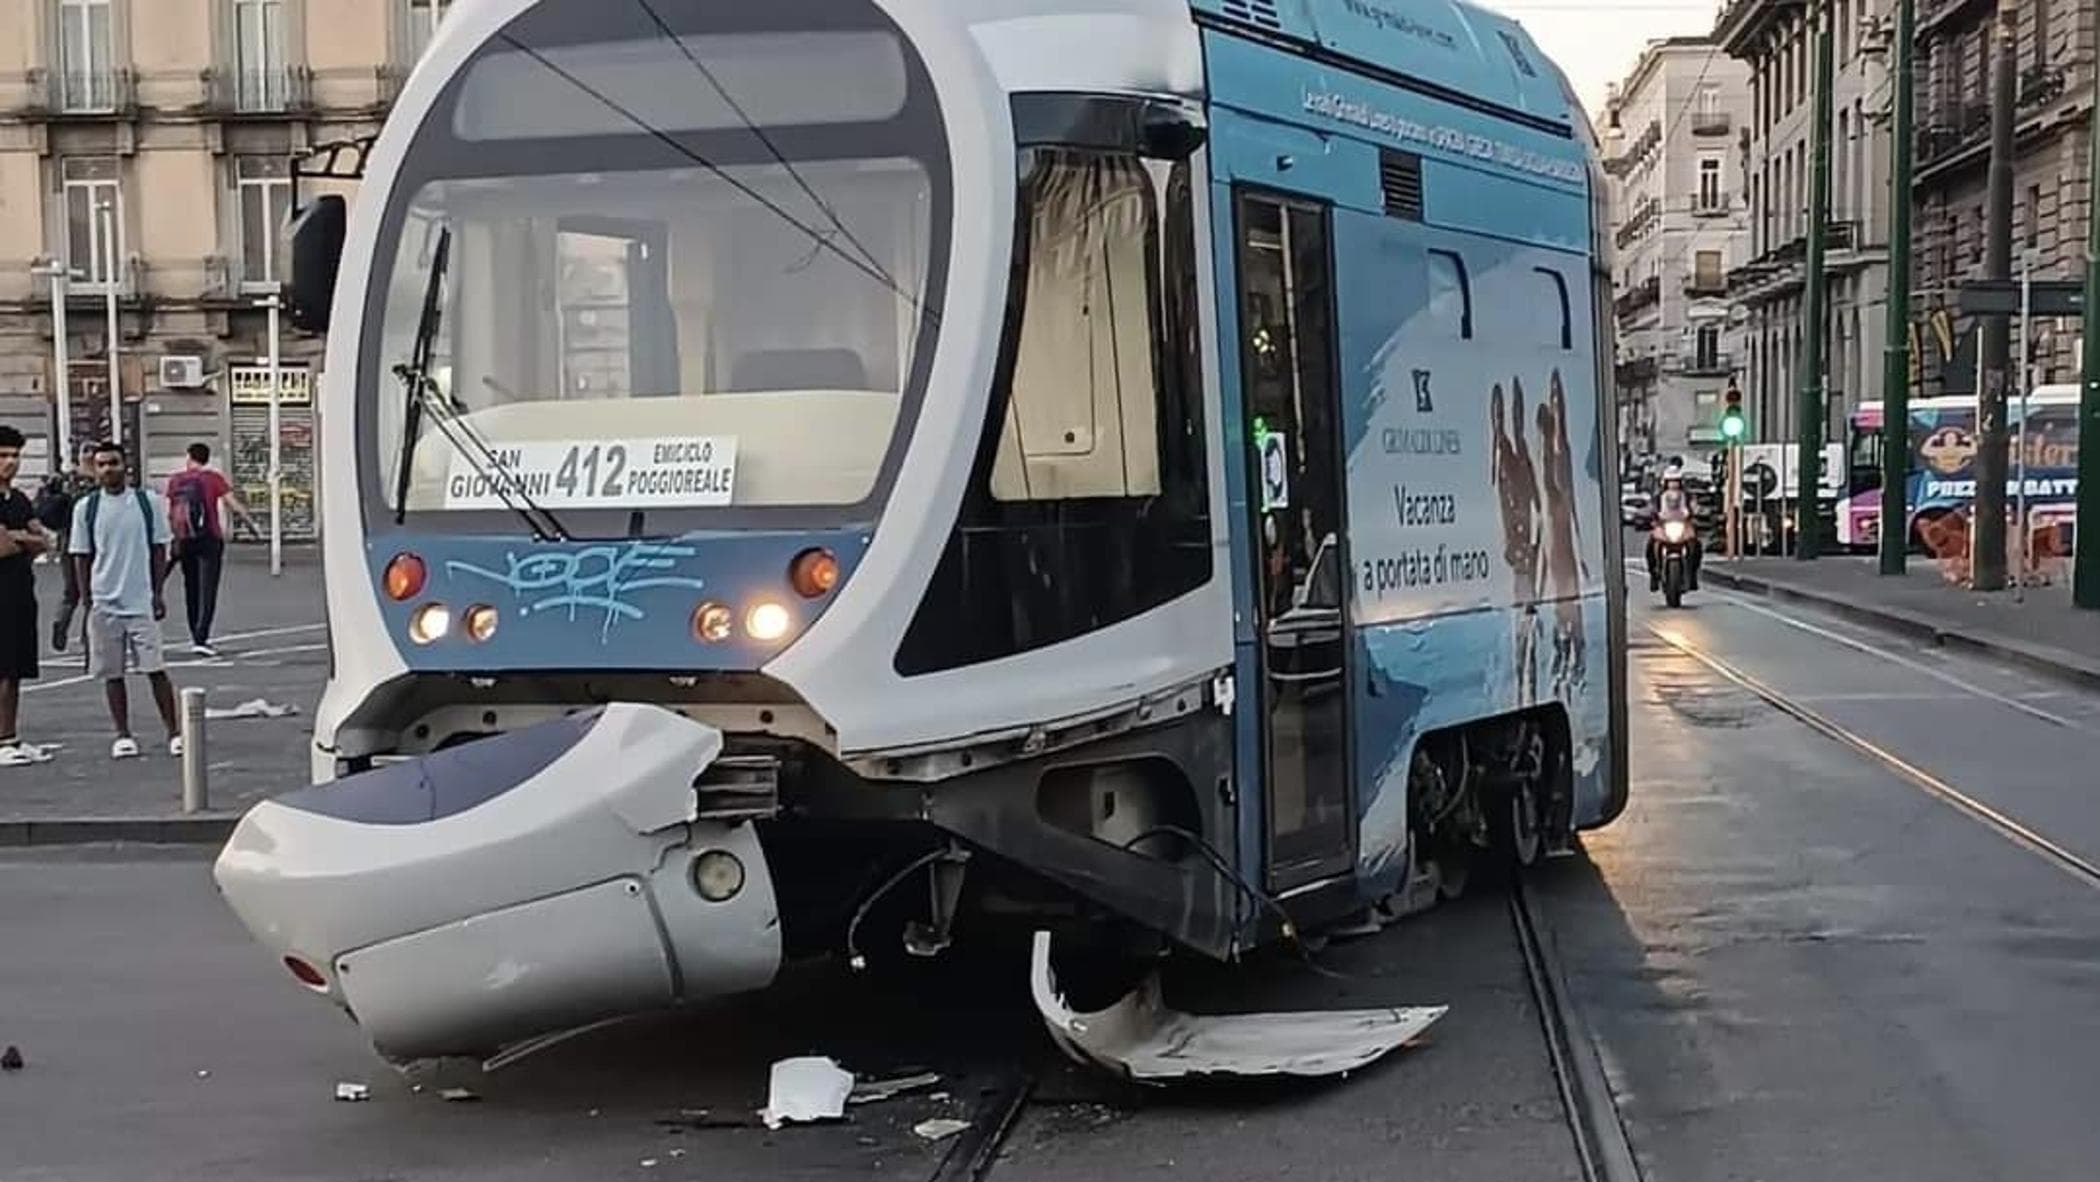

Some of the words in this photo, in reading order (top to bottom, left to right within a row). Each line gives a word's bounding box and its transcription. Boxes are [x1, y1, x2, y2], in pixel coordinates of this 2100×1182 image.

[486, 449, 522, 469] SAN
[653, 441, 713, 464] EMICICLO
[555, 444, 627, 498] 412
[627, 467, 733, 494] POGGIOREALE
[1394, 484, 1456, 526] Vacanza
[1363, 559, 1373, 591] a
[1377, 548, 1431, 601] portata
[1433, 542, 1448, 584] di
[1450, 551, 1489, 582] mano
